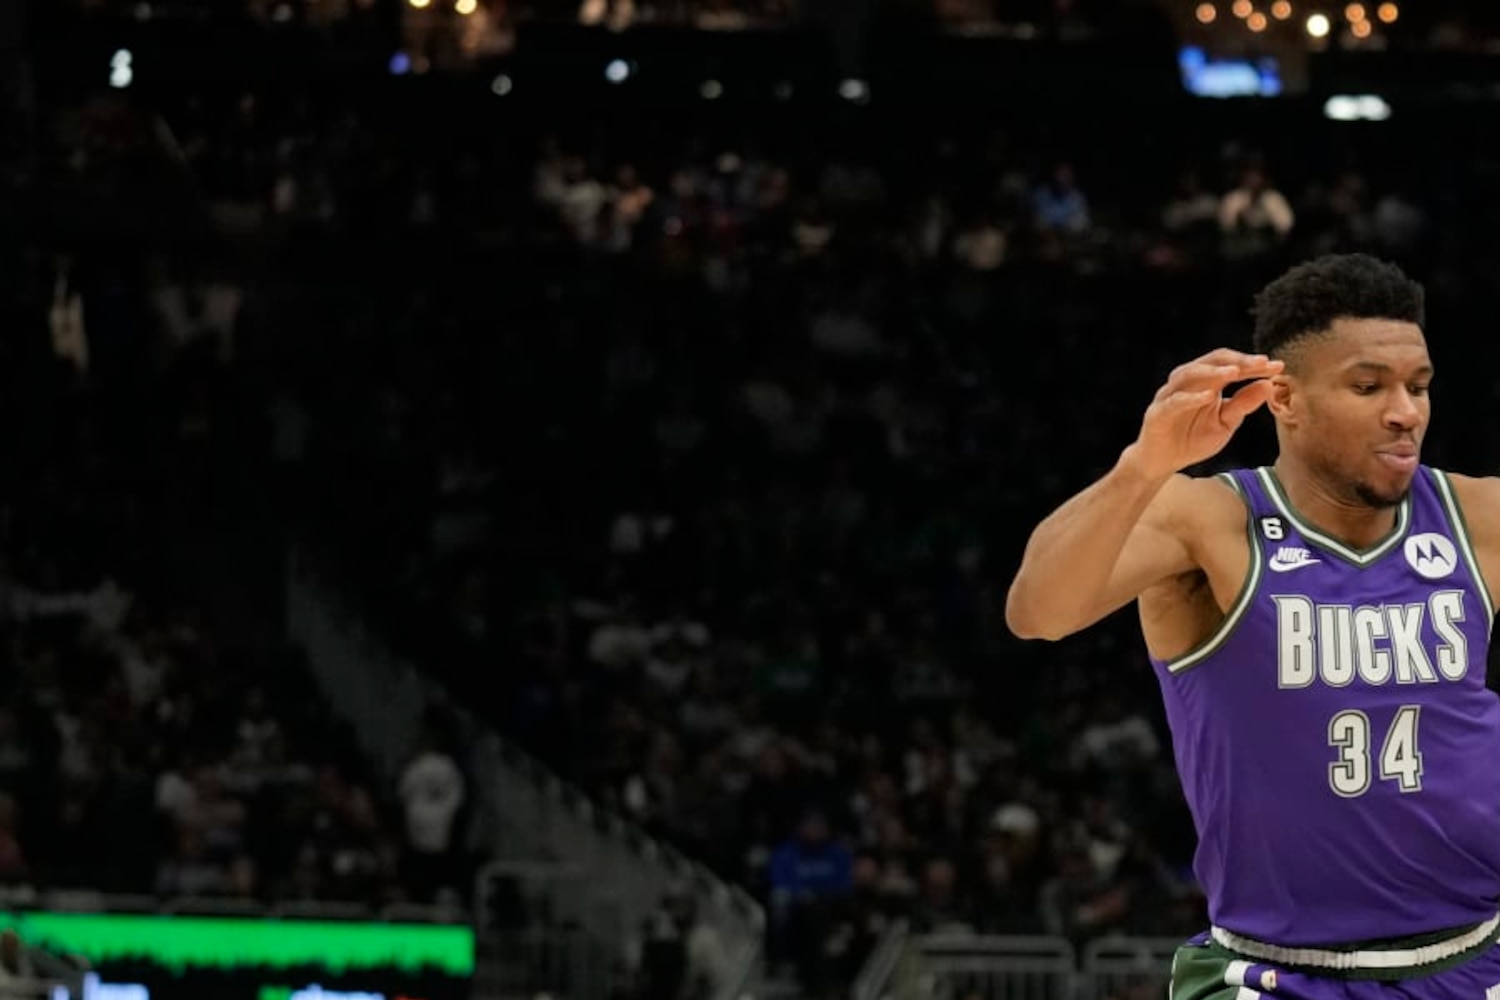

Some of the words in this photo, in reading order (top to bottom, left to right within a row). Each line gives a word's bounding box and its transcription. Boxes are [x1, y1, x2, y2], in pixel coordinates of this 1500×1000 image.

[1262, 517, 1284, 540] 6
[1276, 546, 1312, 563] NIKE
[1270, 589, 1469, 689] BUCKS
[1328, 704, 1424, 798] 34
